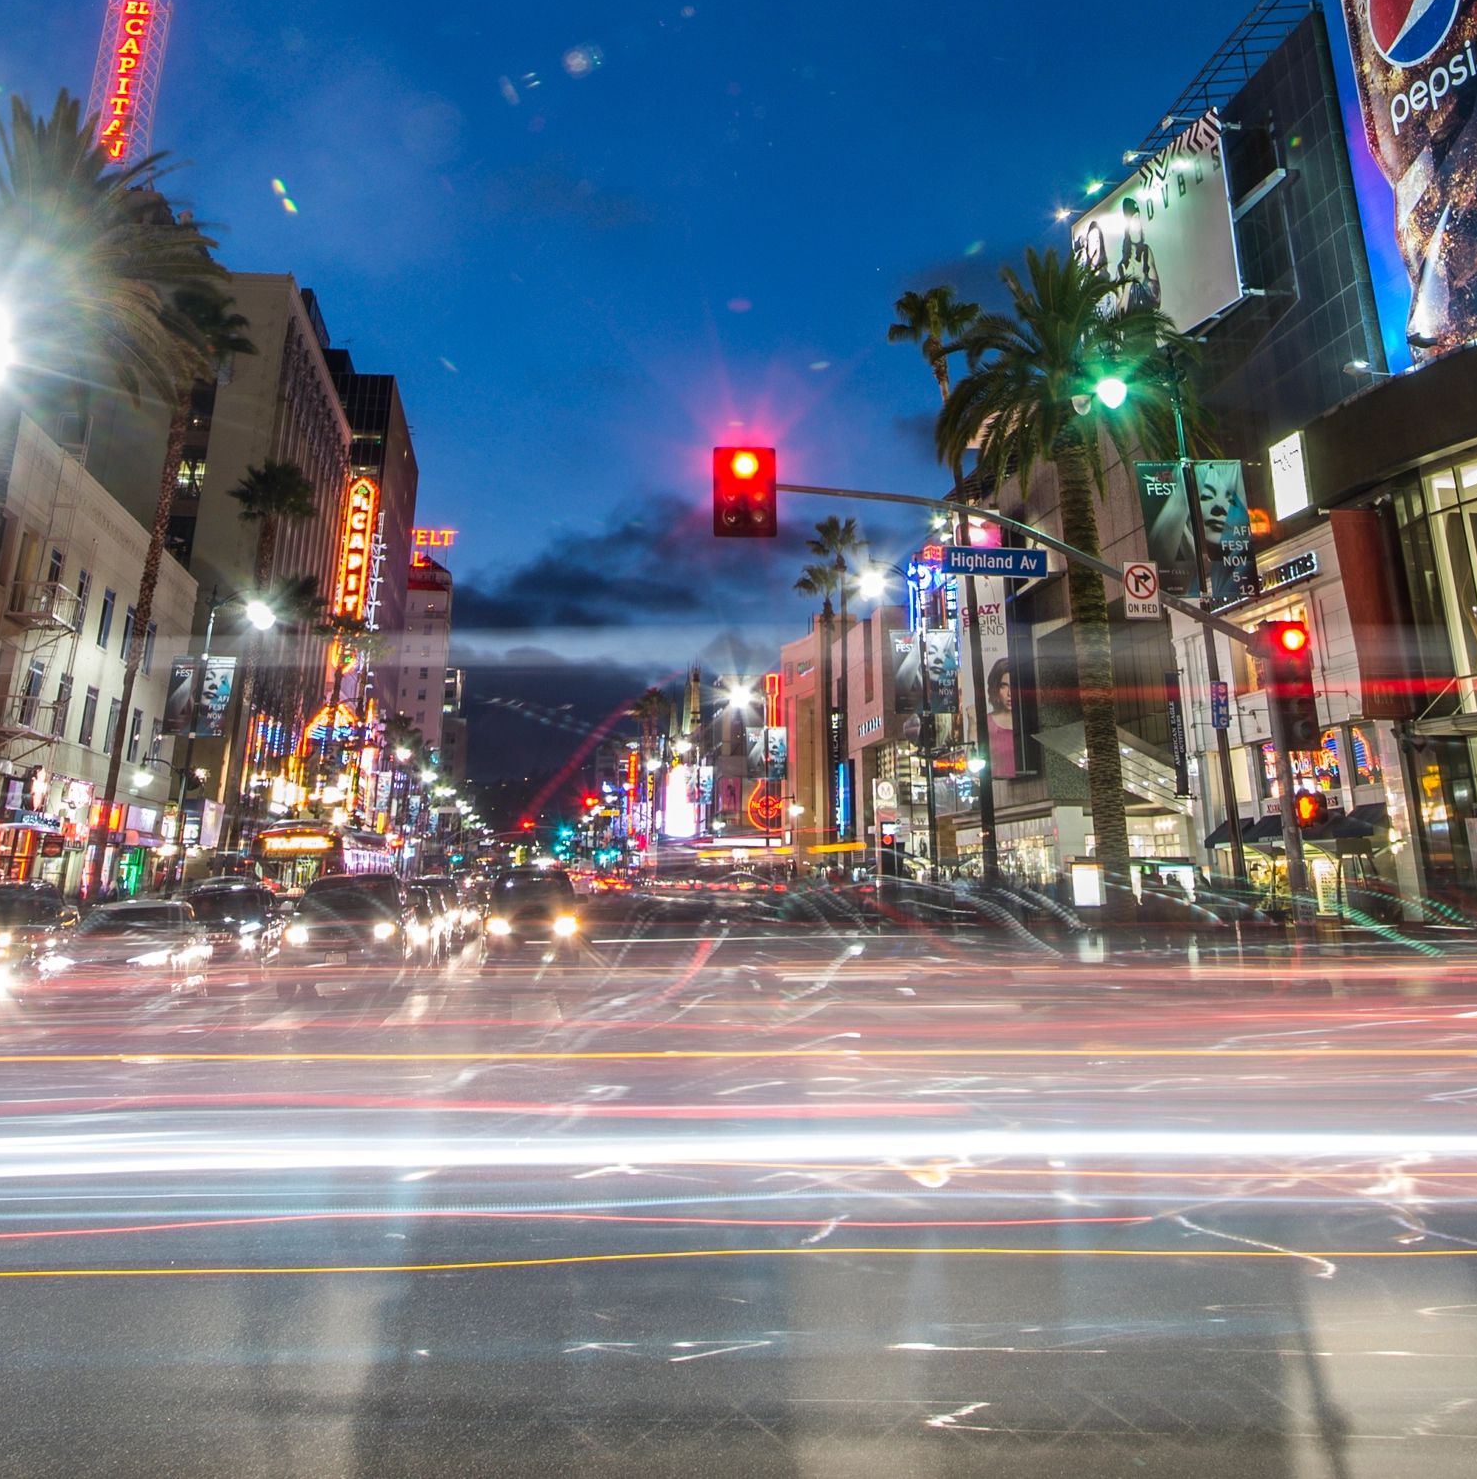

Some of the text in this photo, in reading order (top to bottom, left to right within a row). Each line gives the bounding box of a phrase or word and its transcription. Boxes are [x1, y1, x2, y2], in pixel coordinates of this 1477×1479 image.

[125, 1, 150, 15] EL
[1146, 482, 1176, 496] FEST
[1232, 526, 1252, 537] AFI
[1221, 540, 1250, 552] FEST
[951, 551, 1013, 572] Highland
[1020, 555, 1038, 571] Av
[1223, 556, 1248, 567] NOV
[1239, 585, 1256, 596] 12
[961, 603, 1001, 618] CAZY
[1127, 603, 1158, 615] ON RED
[962, 625, 1005, 637] FEND
[896, 643, 914, 653] FEST
[175, 669, 193, 678] FEST
[938, 688, 954, 696] NOV
[1217, 683, 1228, 727] SYNC
[1168, 701, 1181, 766] AMERICAN EAGLE
[1176, 714, 1185, 753] OUTFITTERS
